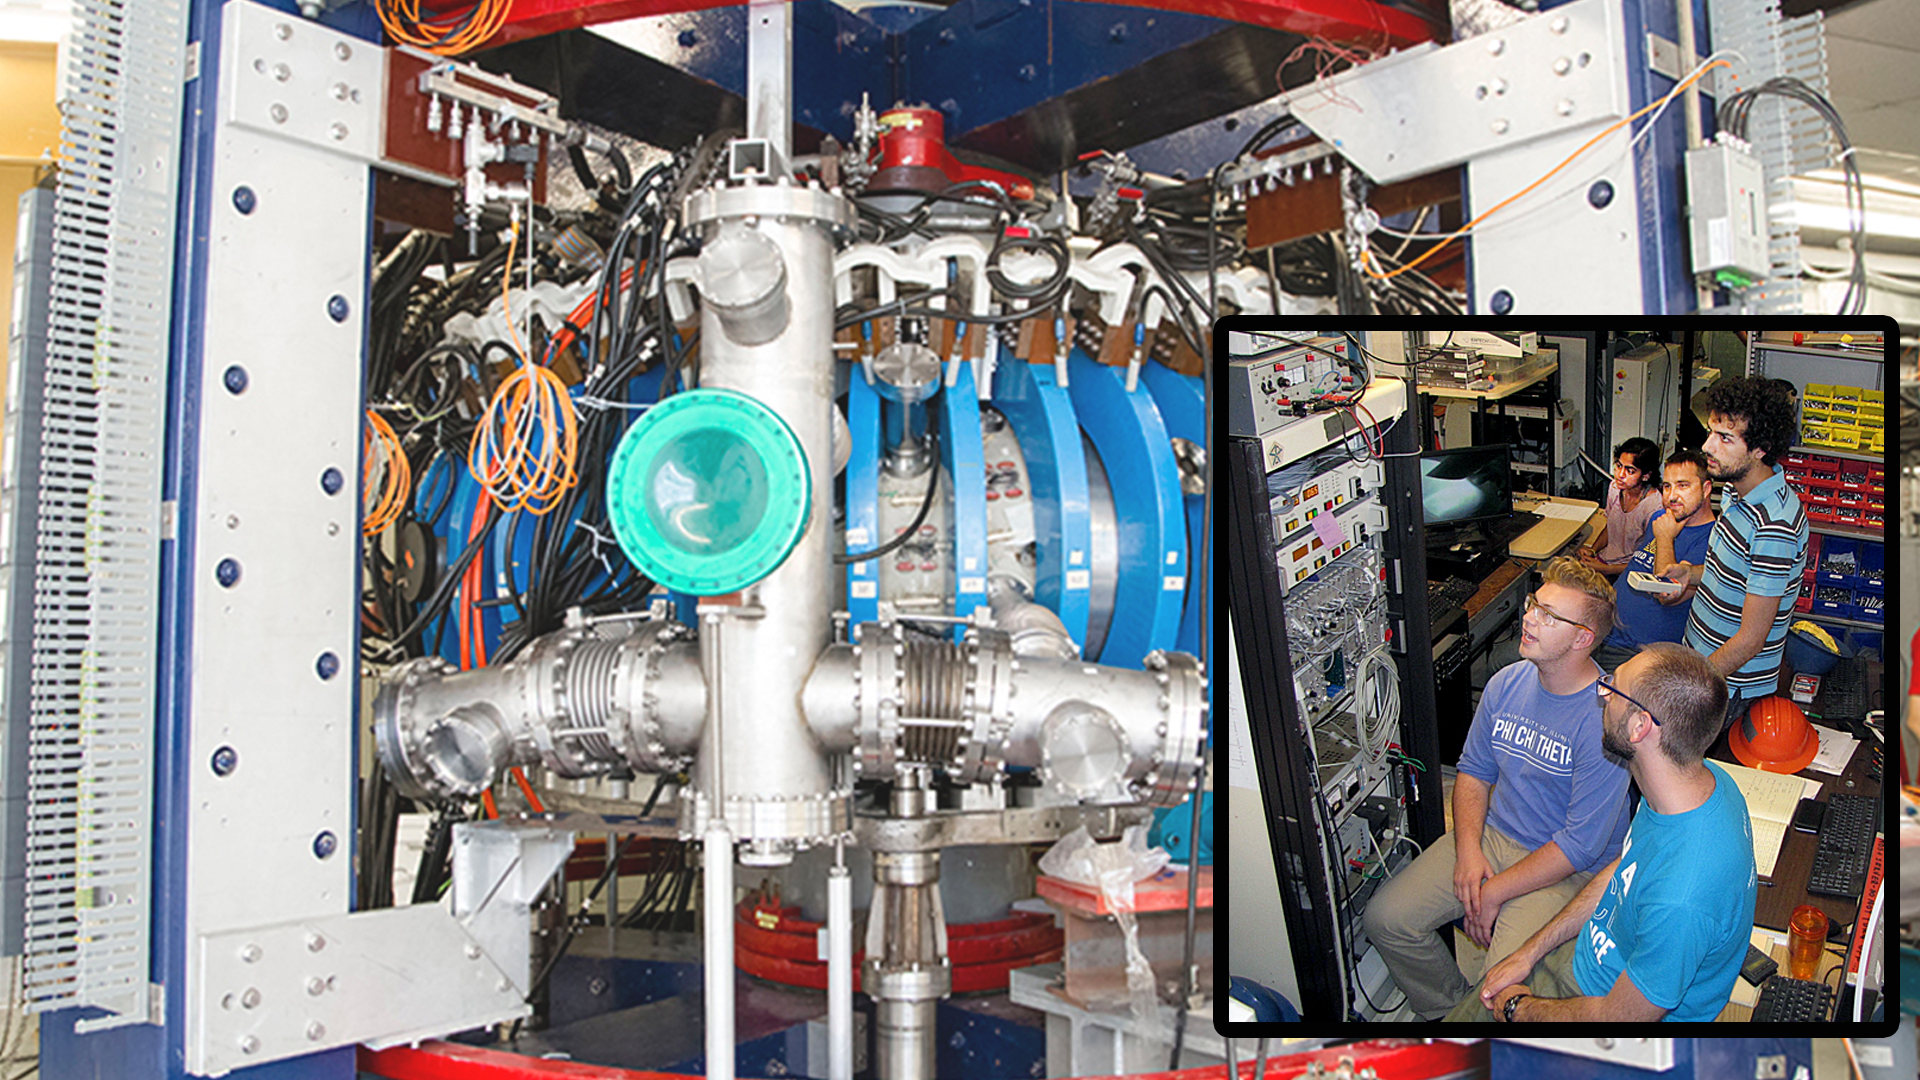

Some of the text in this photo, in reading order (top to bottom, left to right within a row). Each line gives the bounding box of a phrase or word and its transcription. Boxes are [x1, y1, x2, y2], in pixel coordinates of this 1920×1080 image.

[1502, 712, 1538, 727] UNIVERSITY
[1492, 719, 1517, 742] PHI
[1515, 725, 1538, 751] CHI
